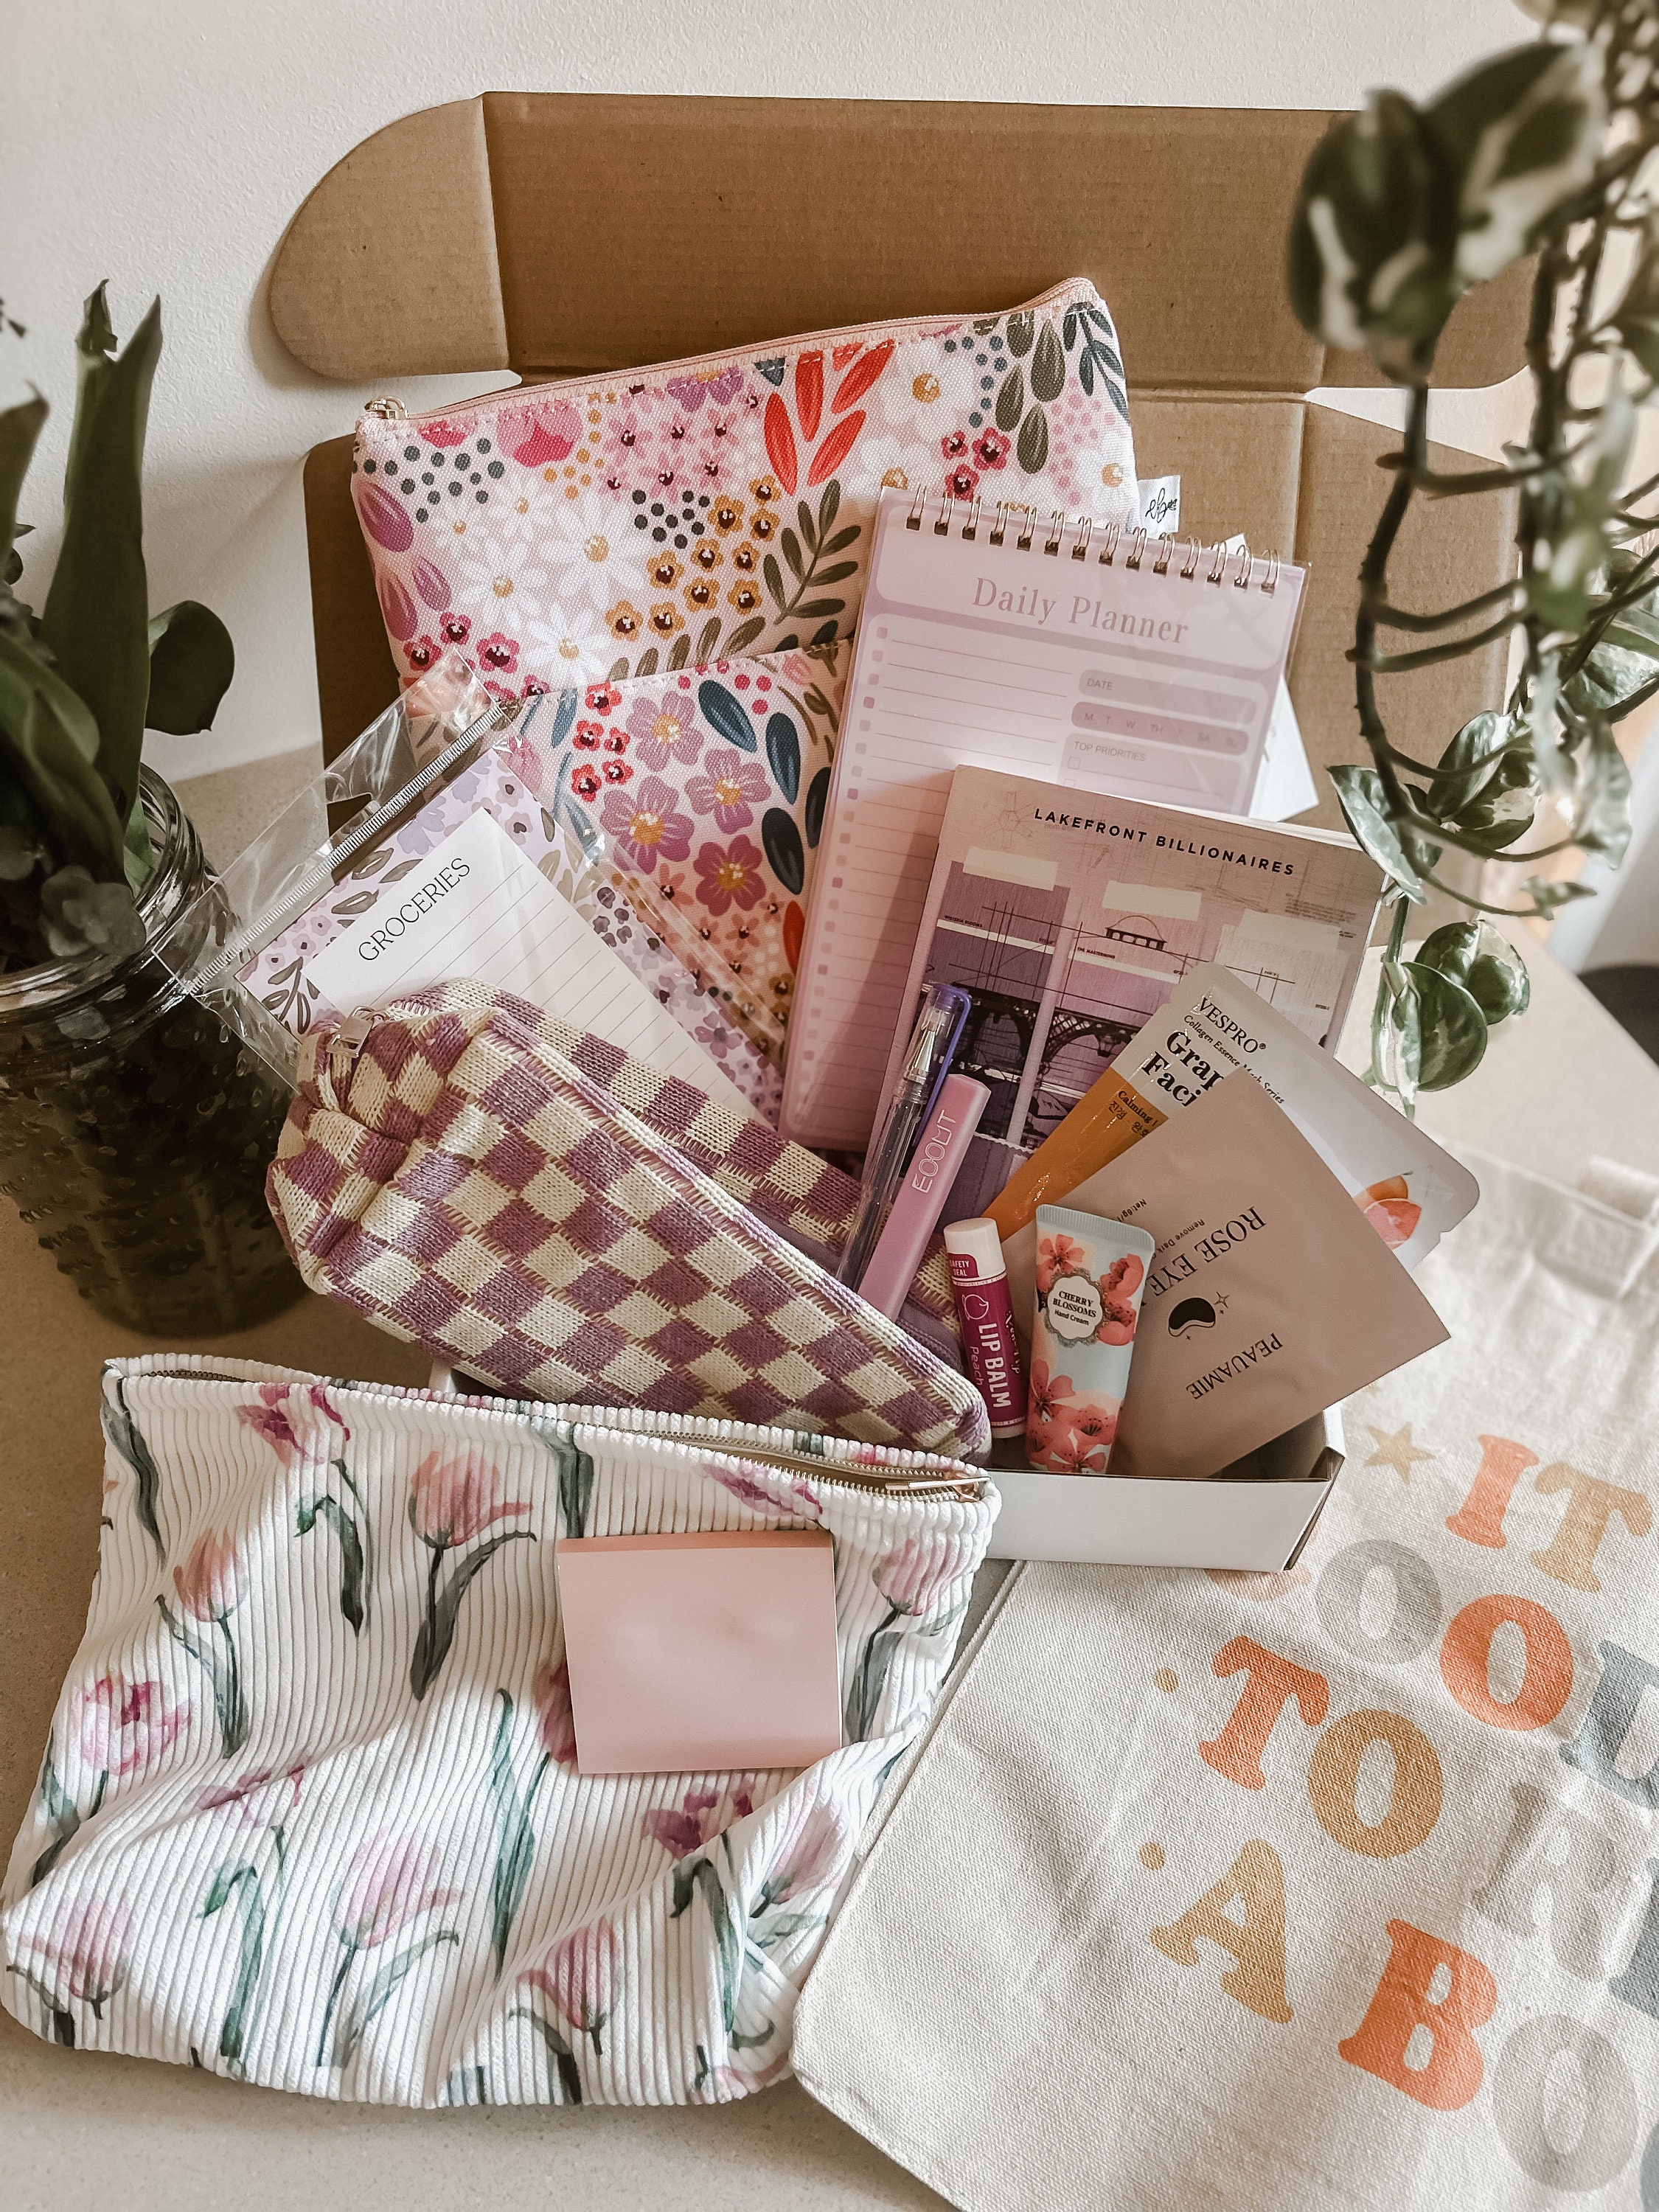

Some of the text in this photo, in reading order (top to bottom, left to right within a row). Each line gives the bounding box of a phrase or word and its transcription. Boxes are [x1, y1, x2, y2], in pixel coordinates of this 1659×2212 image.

[972, 577, 1188, 644] Daily Planner
[1087, 678, 1113, 691] DATE
[1084, 712, 1094, 722] M
[1105, 715, 1113, 724] T
[1126, 720, 1137, 728] W
[1074, 741, 1147, 762] TOP PRIORITIES
[1034, 808, 1295, 876] LAKEFRONT BILLIONAIRES
[358, 858, 470, 961] GROCERIES
[1184, 1015, 1214, 1044] Collagen
[1213, 1040, 1240, 1067] Essence
[1119, 1090, 1153, 1124] Calming
[1144, 1206, 1267, 1297] ROSE EYE
[1156, 1219, 1205, 1253] Remove Dark
[950, 1259, 970, 1268] SAFETY
[953, 1268, 968, 1276] SEAL
[1052, 1298, 1097, 1318] BLOSSOMS
[1058, 1290, 1093, 1307] CHERRY
[1054, 1309, 1089, 1326] Hand Cream
[978, 1323, 1001, 1352] LIP
[970, 1346, 984, 1386] Peach
[984, 1356, 1012, 1408] BALM
[1186, 1332, 1284, 1400] PEAUAMIE
[1444, 1434, 1653, 1593] IT
[1198, 1635, 1444, 1859] TO
[1150, 1839, 1294, 2025] A
